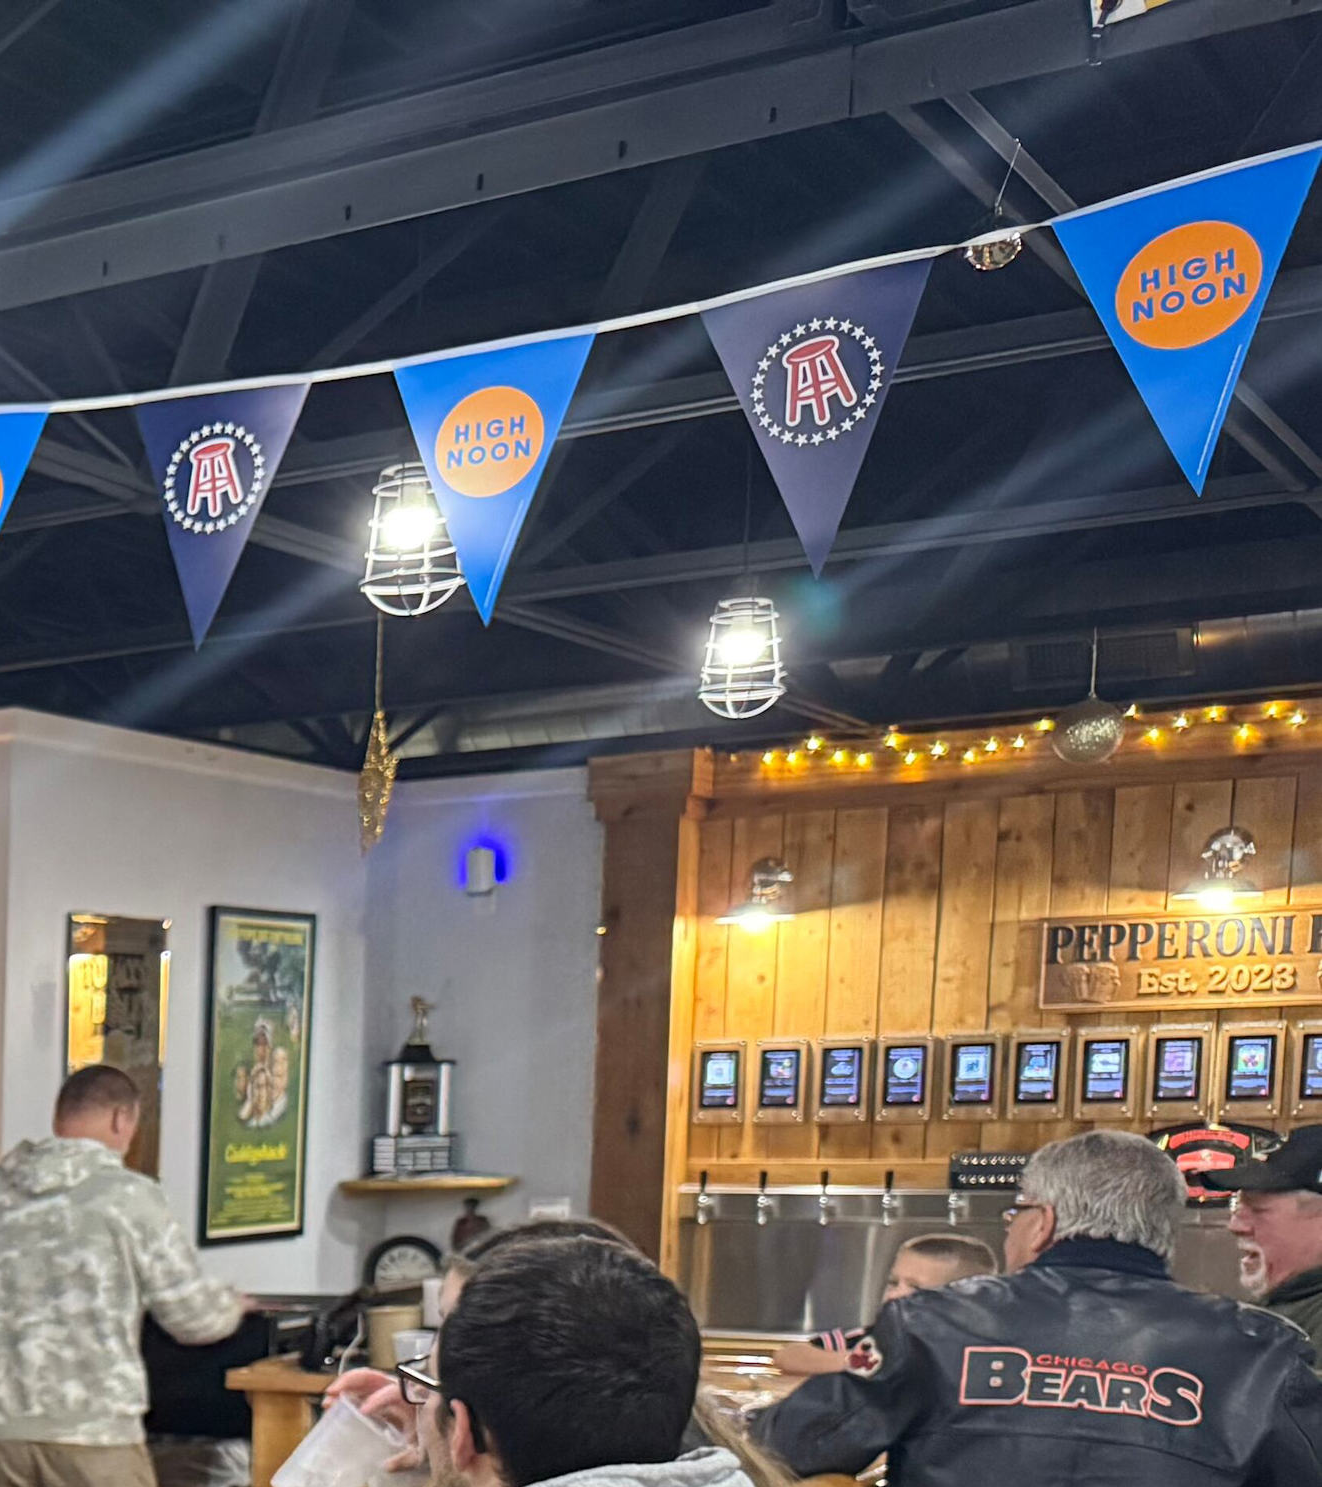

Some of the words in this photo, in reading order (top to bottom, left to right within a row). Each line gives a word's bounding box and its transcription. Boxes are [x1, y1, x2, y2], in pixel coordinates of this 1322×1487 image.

[1139, 247, 1236, 294] HIGH
[1131, 272, 1247, 323] NOON
[454, 414, 526, 445] HIGH
[446, 437, 531, 470] NOON
[1047, 914, 1297, 965] PEPPERONI
[1137, 966, 1198, 995] Est.
[1208, 963, 1297, 993] 2023
[1036, 1353, 1148, 1376] CHICAGO
[959, 1346, 1204, 1426] BEARS
